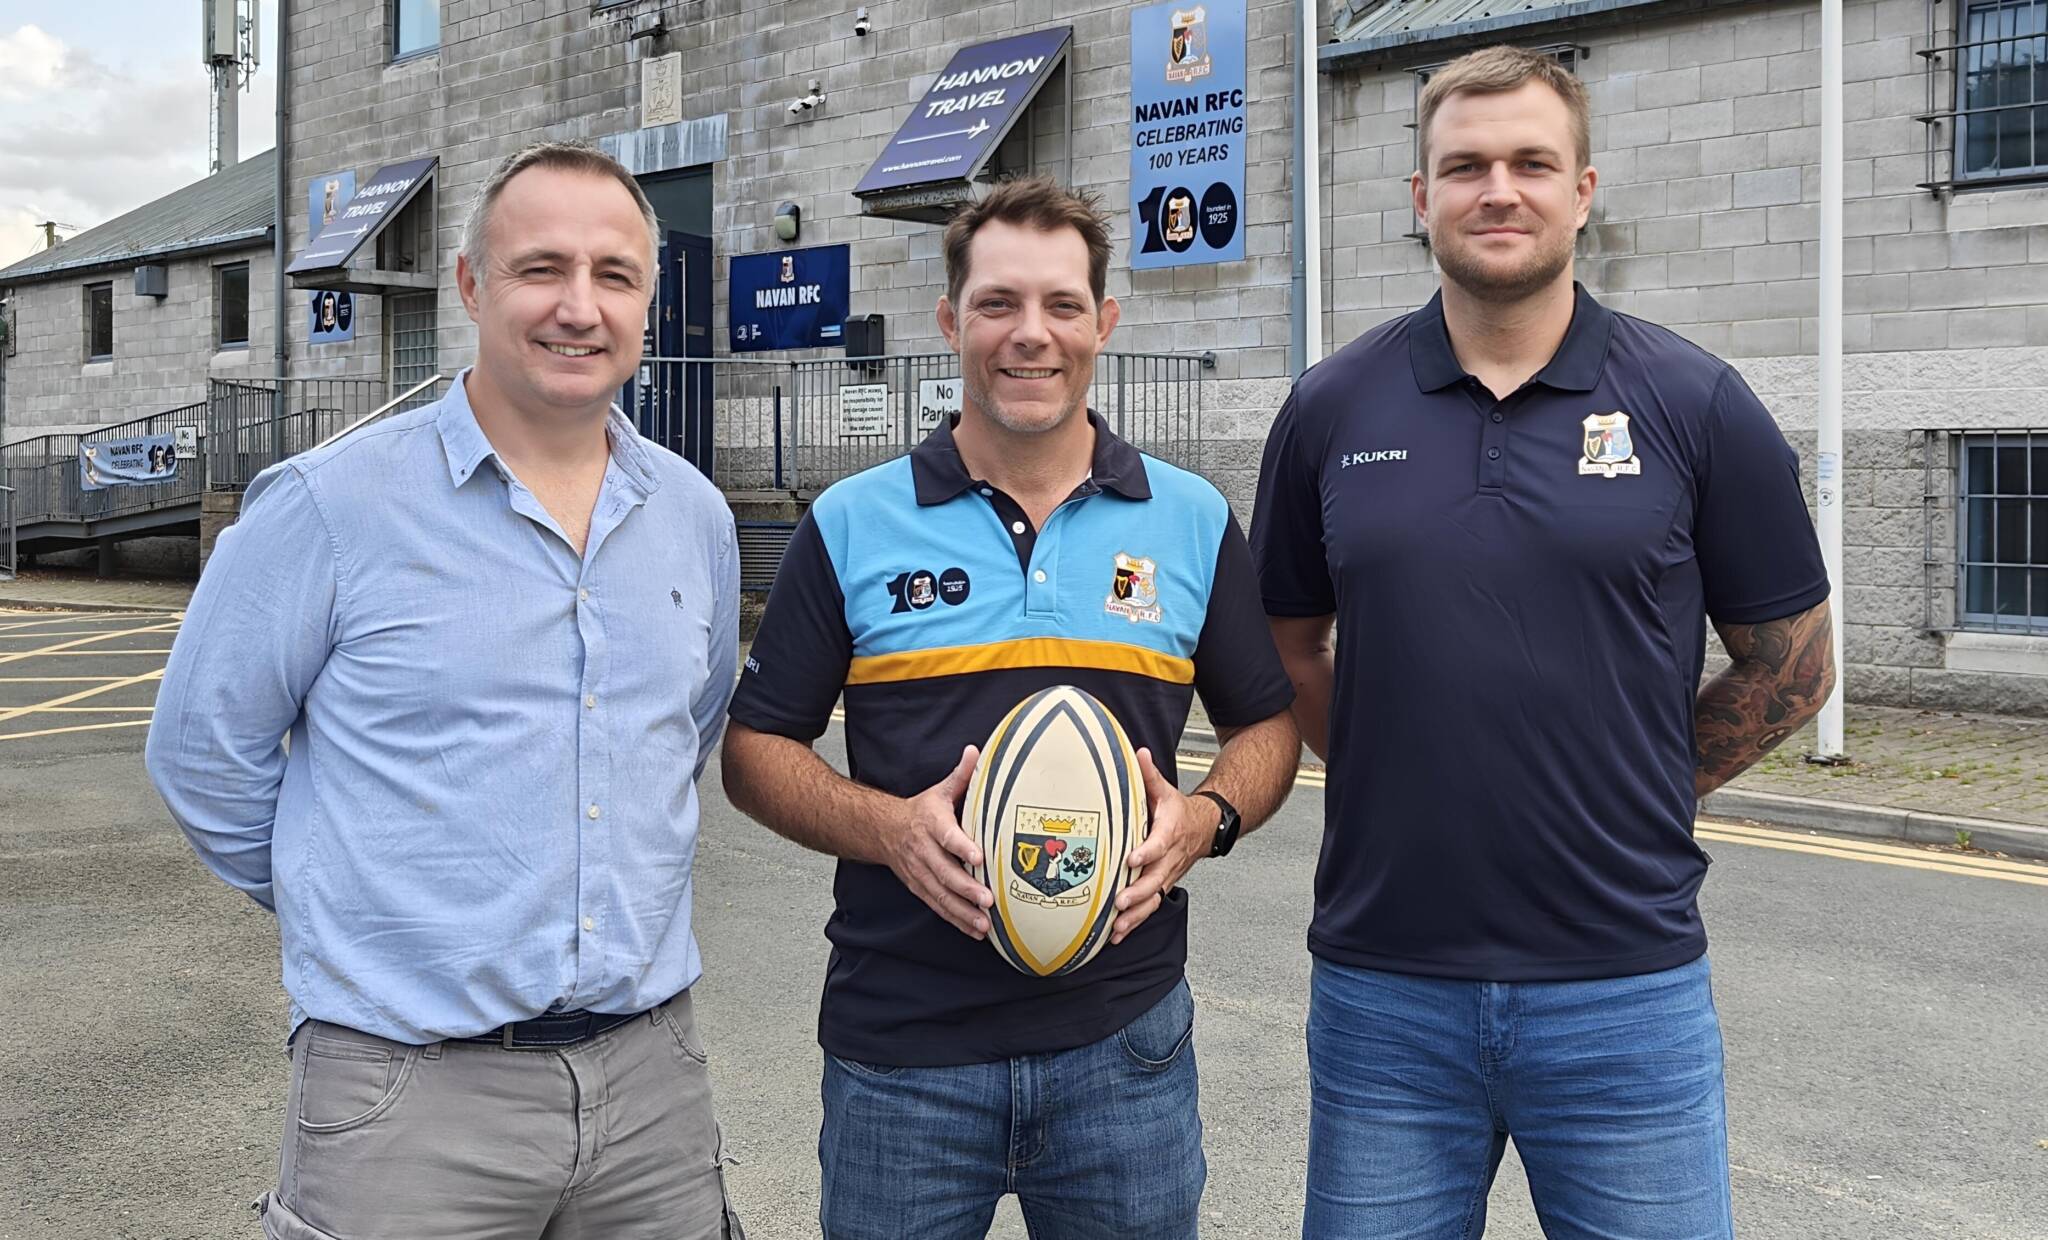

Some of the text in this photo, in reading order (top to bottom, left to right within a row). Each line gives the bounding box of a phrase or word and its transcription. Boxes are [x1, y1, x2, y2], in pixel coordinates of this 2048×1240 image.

[932, 56, 1045, 92] HANNON
[924, 89, 1007, 118] TRAVEL
[1135, 89, 1243, 123] NAVAN RFC
[1136, 116, 1244, 147] CELEBRATING
[1149, 144, 1229, 170] 100 YEARS
[354, 178, 416, 199] HANNON
[342, 201, 388, 219] TRAVEL
[1208, 212, 1229, 225] 1925
[755, 284, 821, 308] NAVAN RFC
[936, 384, 954, 400] No
[921, 405, 961, 422] Park
[182, 430, 189, 439] No
[110, 444, 143, 456] NAVAN RFC
[176, 443, 195, 455] Parking
[1353, 450, 1408, 465] KUKRI
[111, 459, 144, 469] CELEBRATING
[1016, 892, 1039, 901] NAVAN
